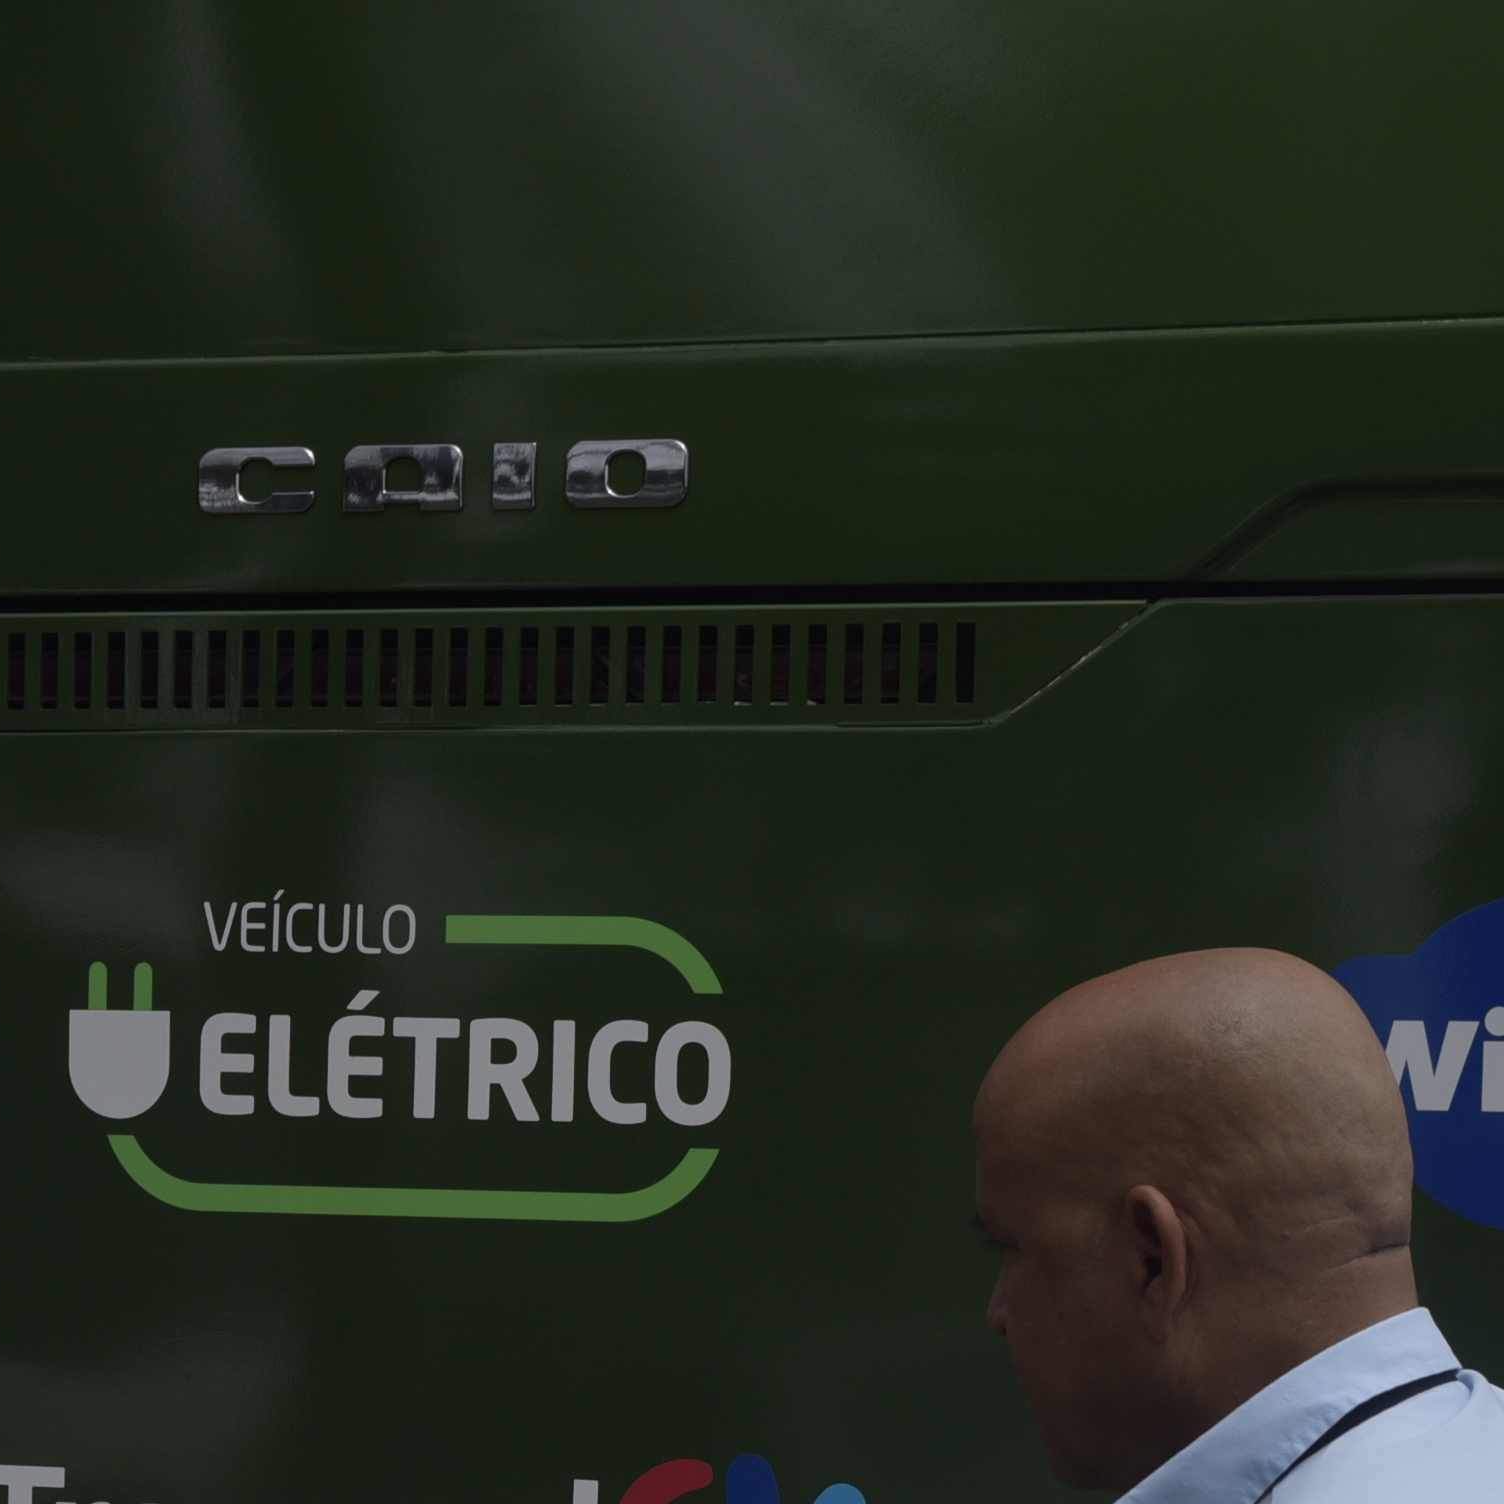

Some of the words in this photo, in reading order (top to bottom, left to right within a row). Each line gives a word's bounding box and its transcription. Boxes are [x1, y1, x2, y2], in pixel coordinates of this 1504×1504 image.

[197, 438, 690, 516] CAIO
[202, 889, 417, 955] VEÍCULO
[198, 989, 733, 1127] ELÉTRICO
